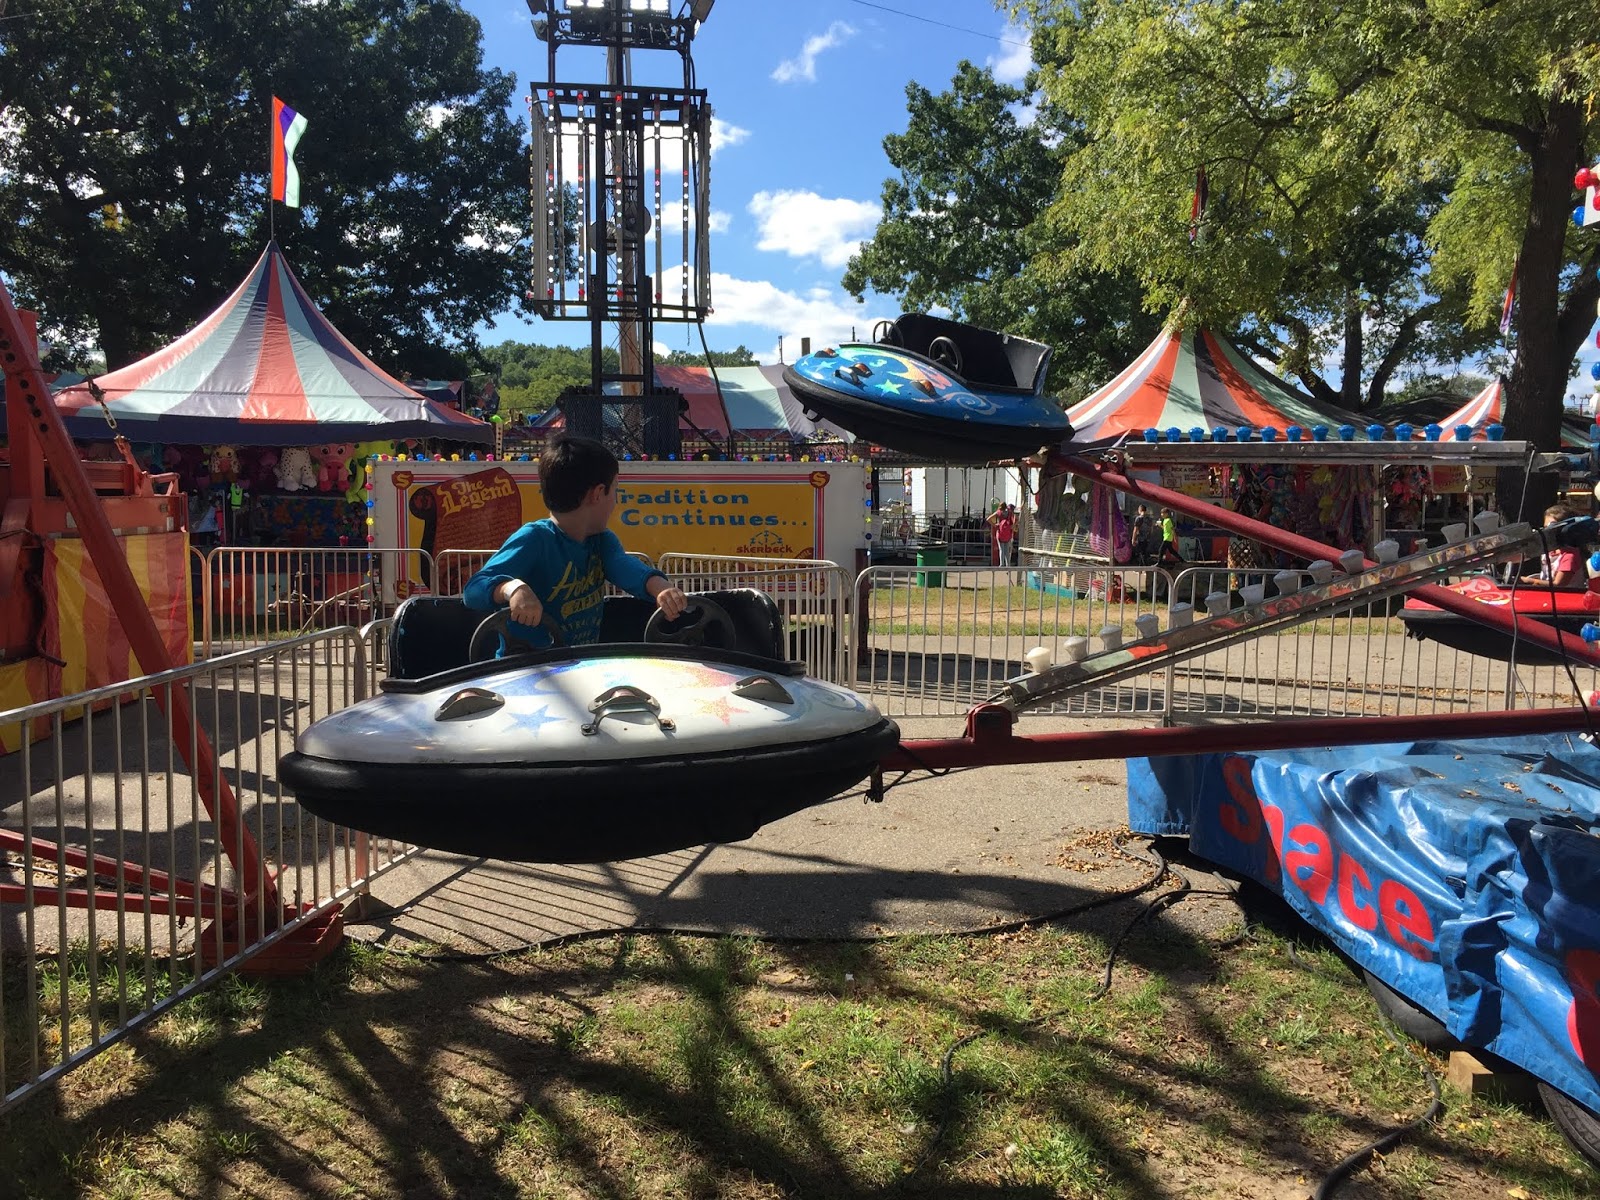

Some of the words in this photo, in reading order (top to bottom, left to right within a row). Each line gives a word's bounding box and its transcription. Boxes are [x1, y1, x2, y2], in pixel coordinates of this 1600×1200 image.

[436, 474, 516, 520] Legend
[451, 480, 485, 496] The
[620, 508, 808, 526] Continues...
